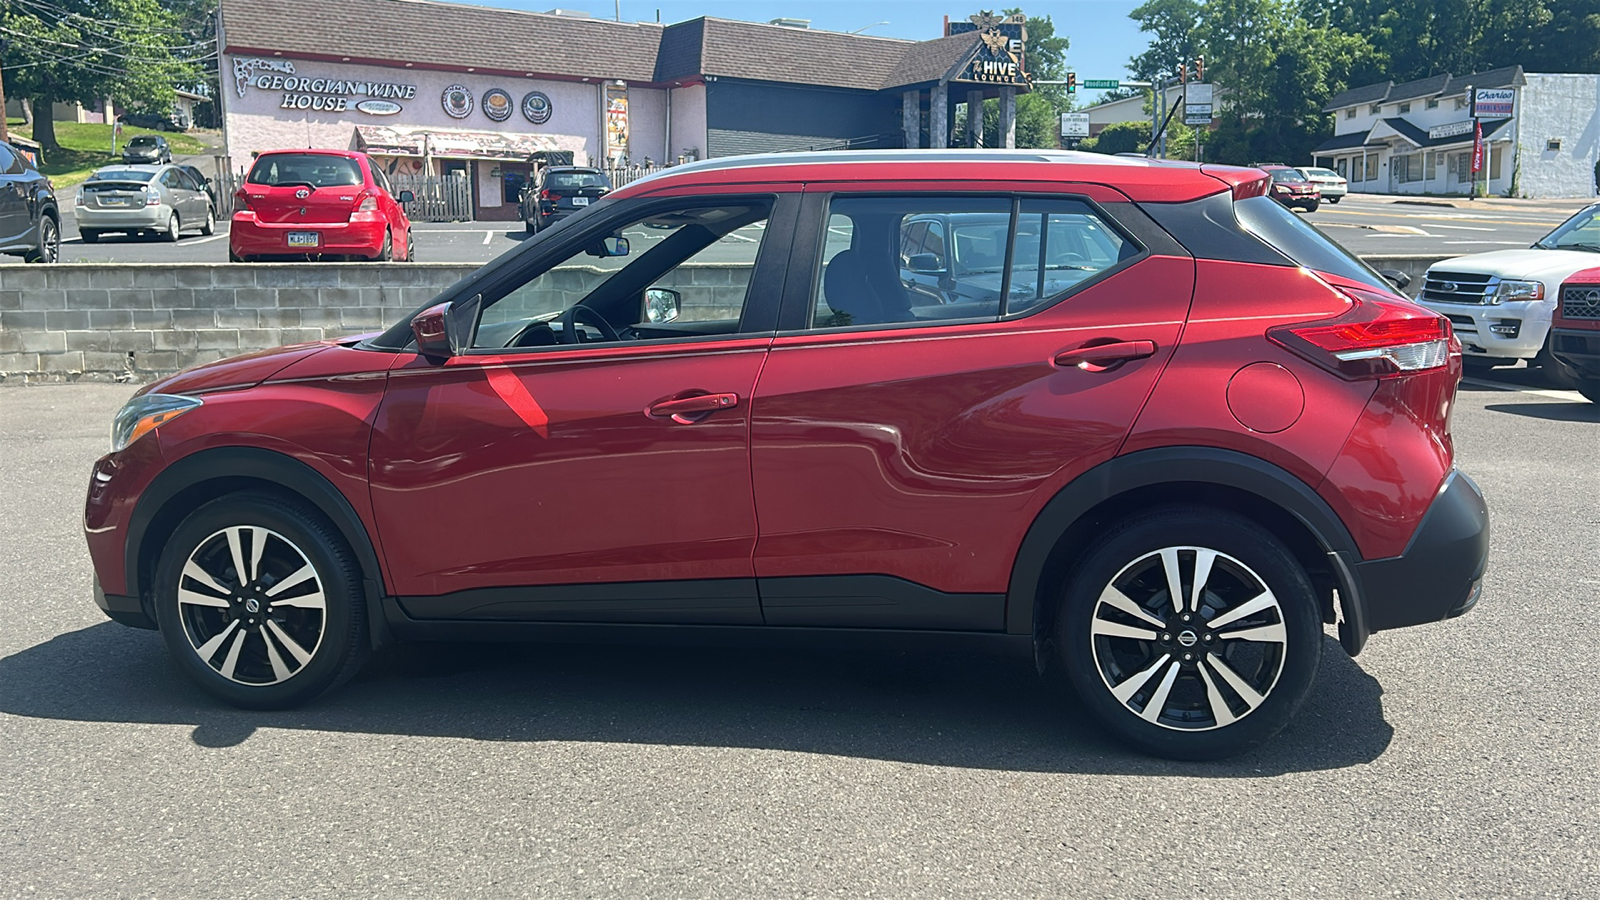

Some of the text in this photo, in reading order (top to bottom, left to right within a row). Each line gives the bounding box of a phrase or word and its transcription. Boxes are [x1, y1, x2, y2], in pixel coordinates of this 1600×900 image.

[983, 60, 1016, 76] HIVE
[257, 75, 417, 100] GEORGIAN WINE
[974, 75, 1016, 83] LOUNGE
[280, 93, 348, 112] HOUSE
